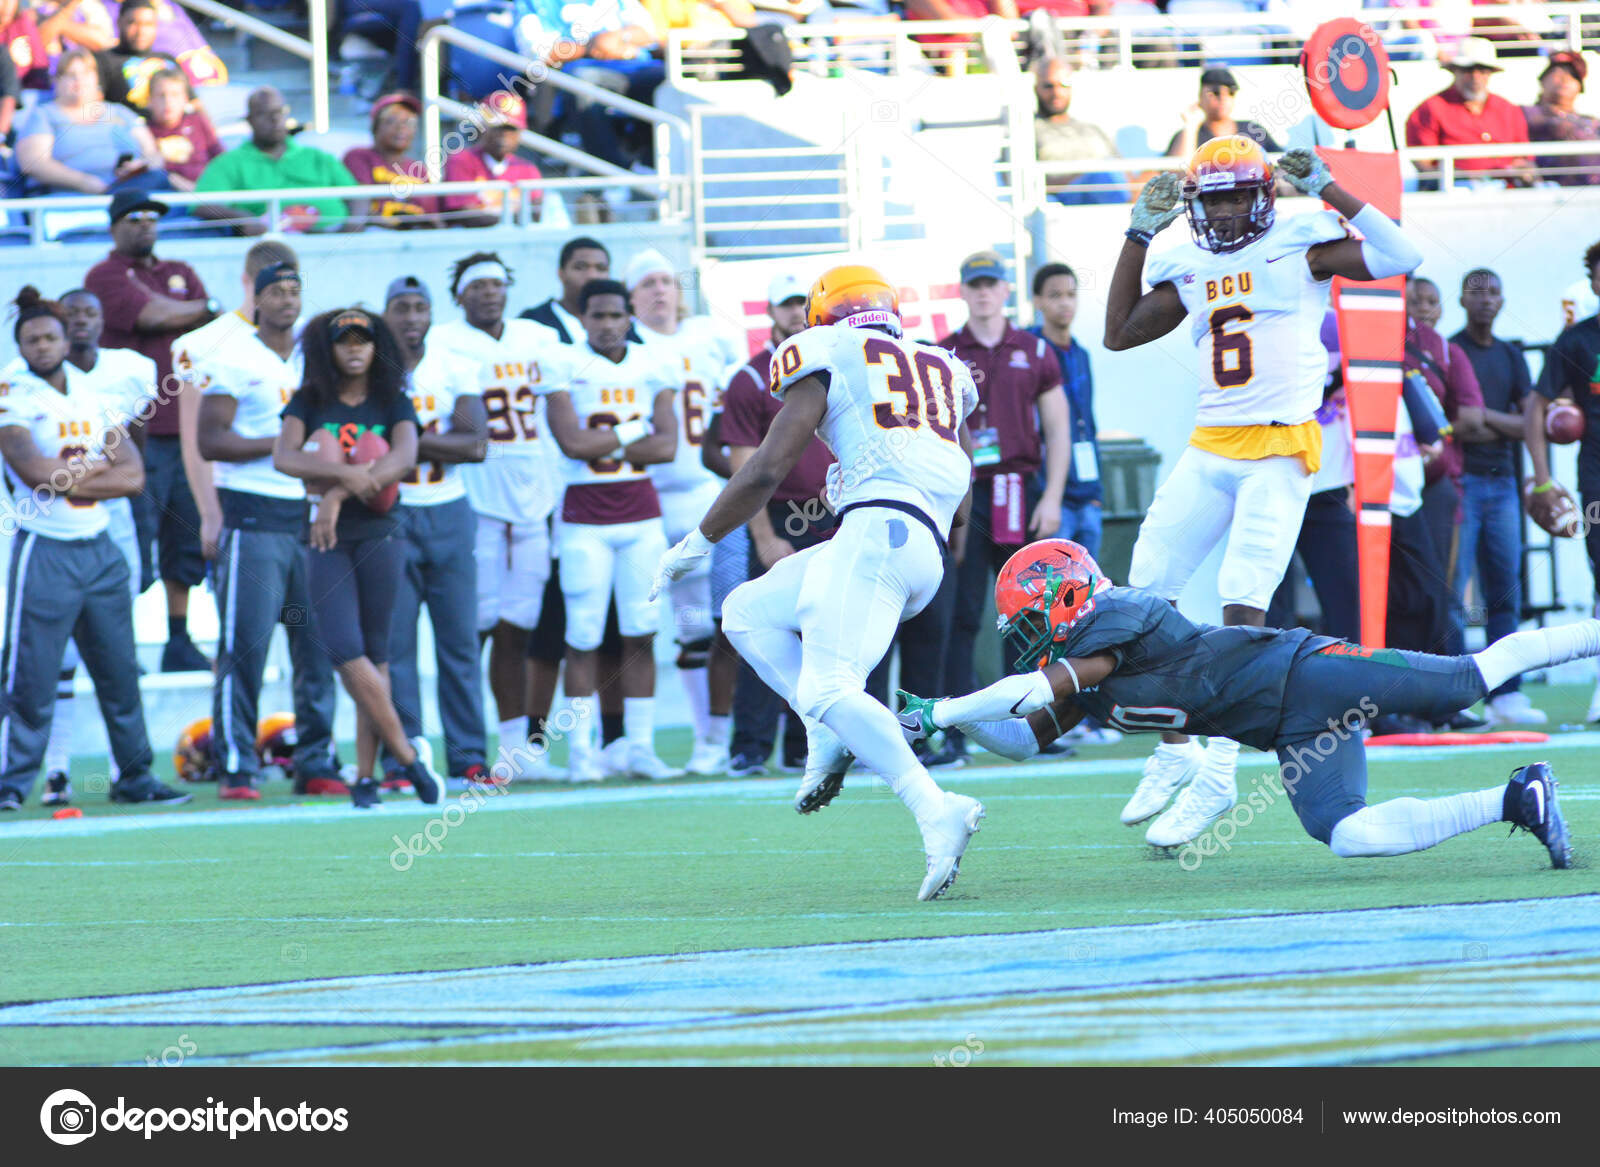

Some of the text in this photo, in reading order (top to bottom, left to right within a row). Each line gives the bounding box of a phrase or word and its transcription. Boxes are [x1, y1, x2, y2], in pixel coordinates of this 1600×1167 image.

[1206, 272, 1253, 303] BCU
[847, 312, 889, 327] Riddell
[768, 344, 803, 393] 30
[1208, 302, 1255, 390] 6
[862, 337, 961, 445] 30
